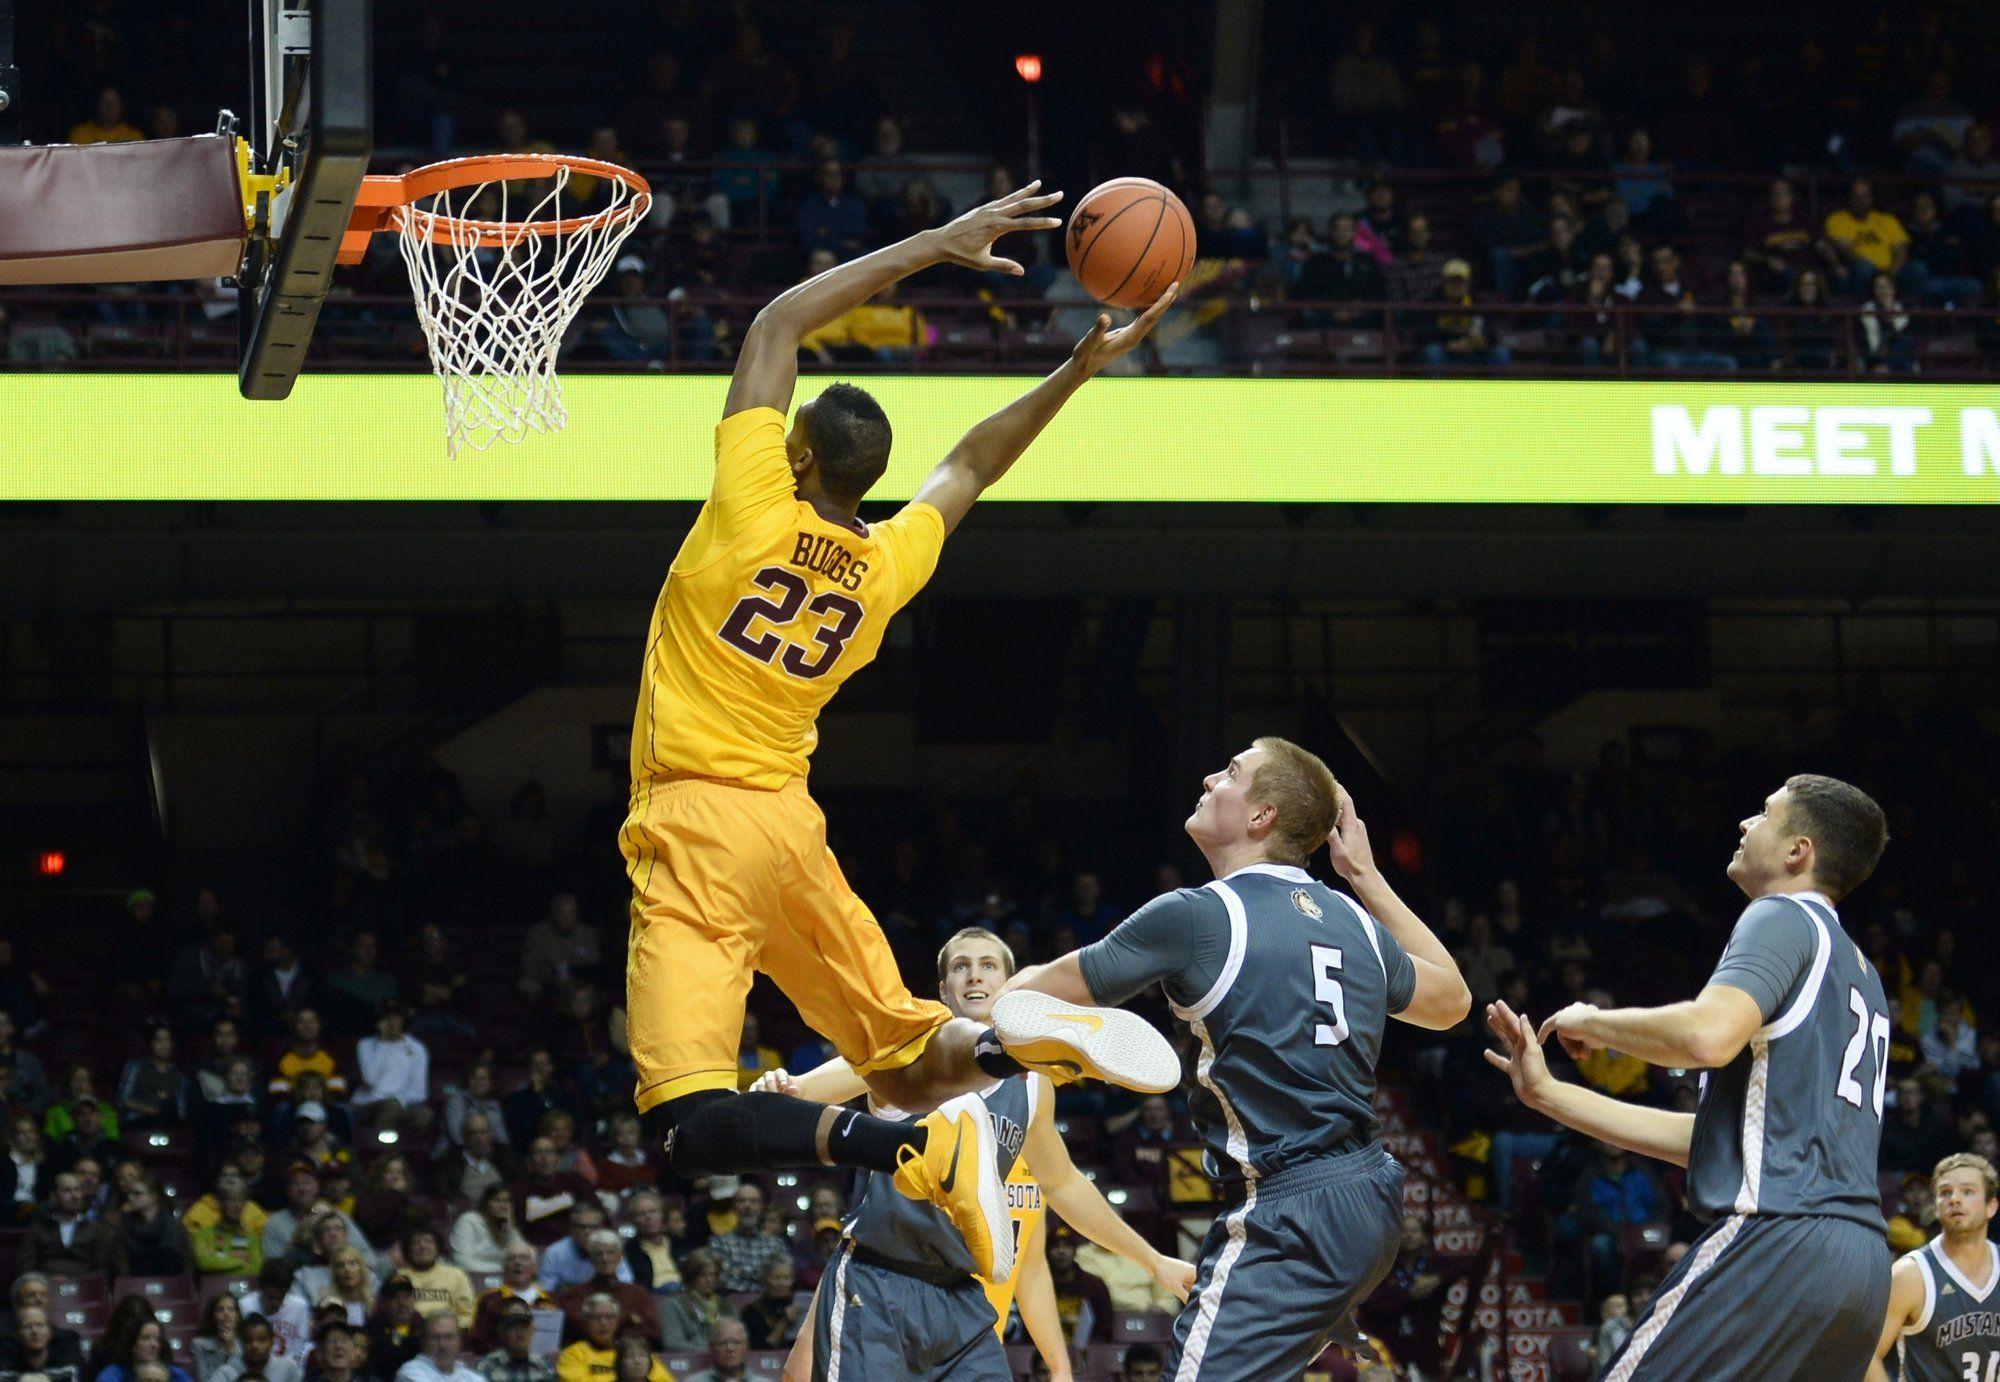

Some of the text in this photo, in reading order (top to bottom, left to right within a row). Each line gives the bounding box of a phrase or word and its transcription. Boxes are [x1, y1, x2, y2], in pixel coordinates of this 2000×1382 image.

[1650, 404, 1934, 477] MEET
[716, 565, 866, 680] 23
[1308, 941, 1350, 1048] 5
[1834, 983, 1890, 1125] 20
